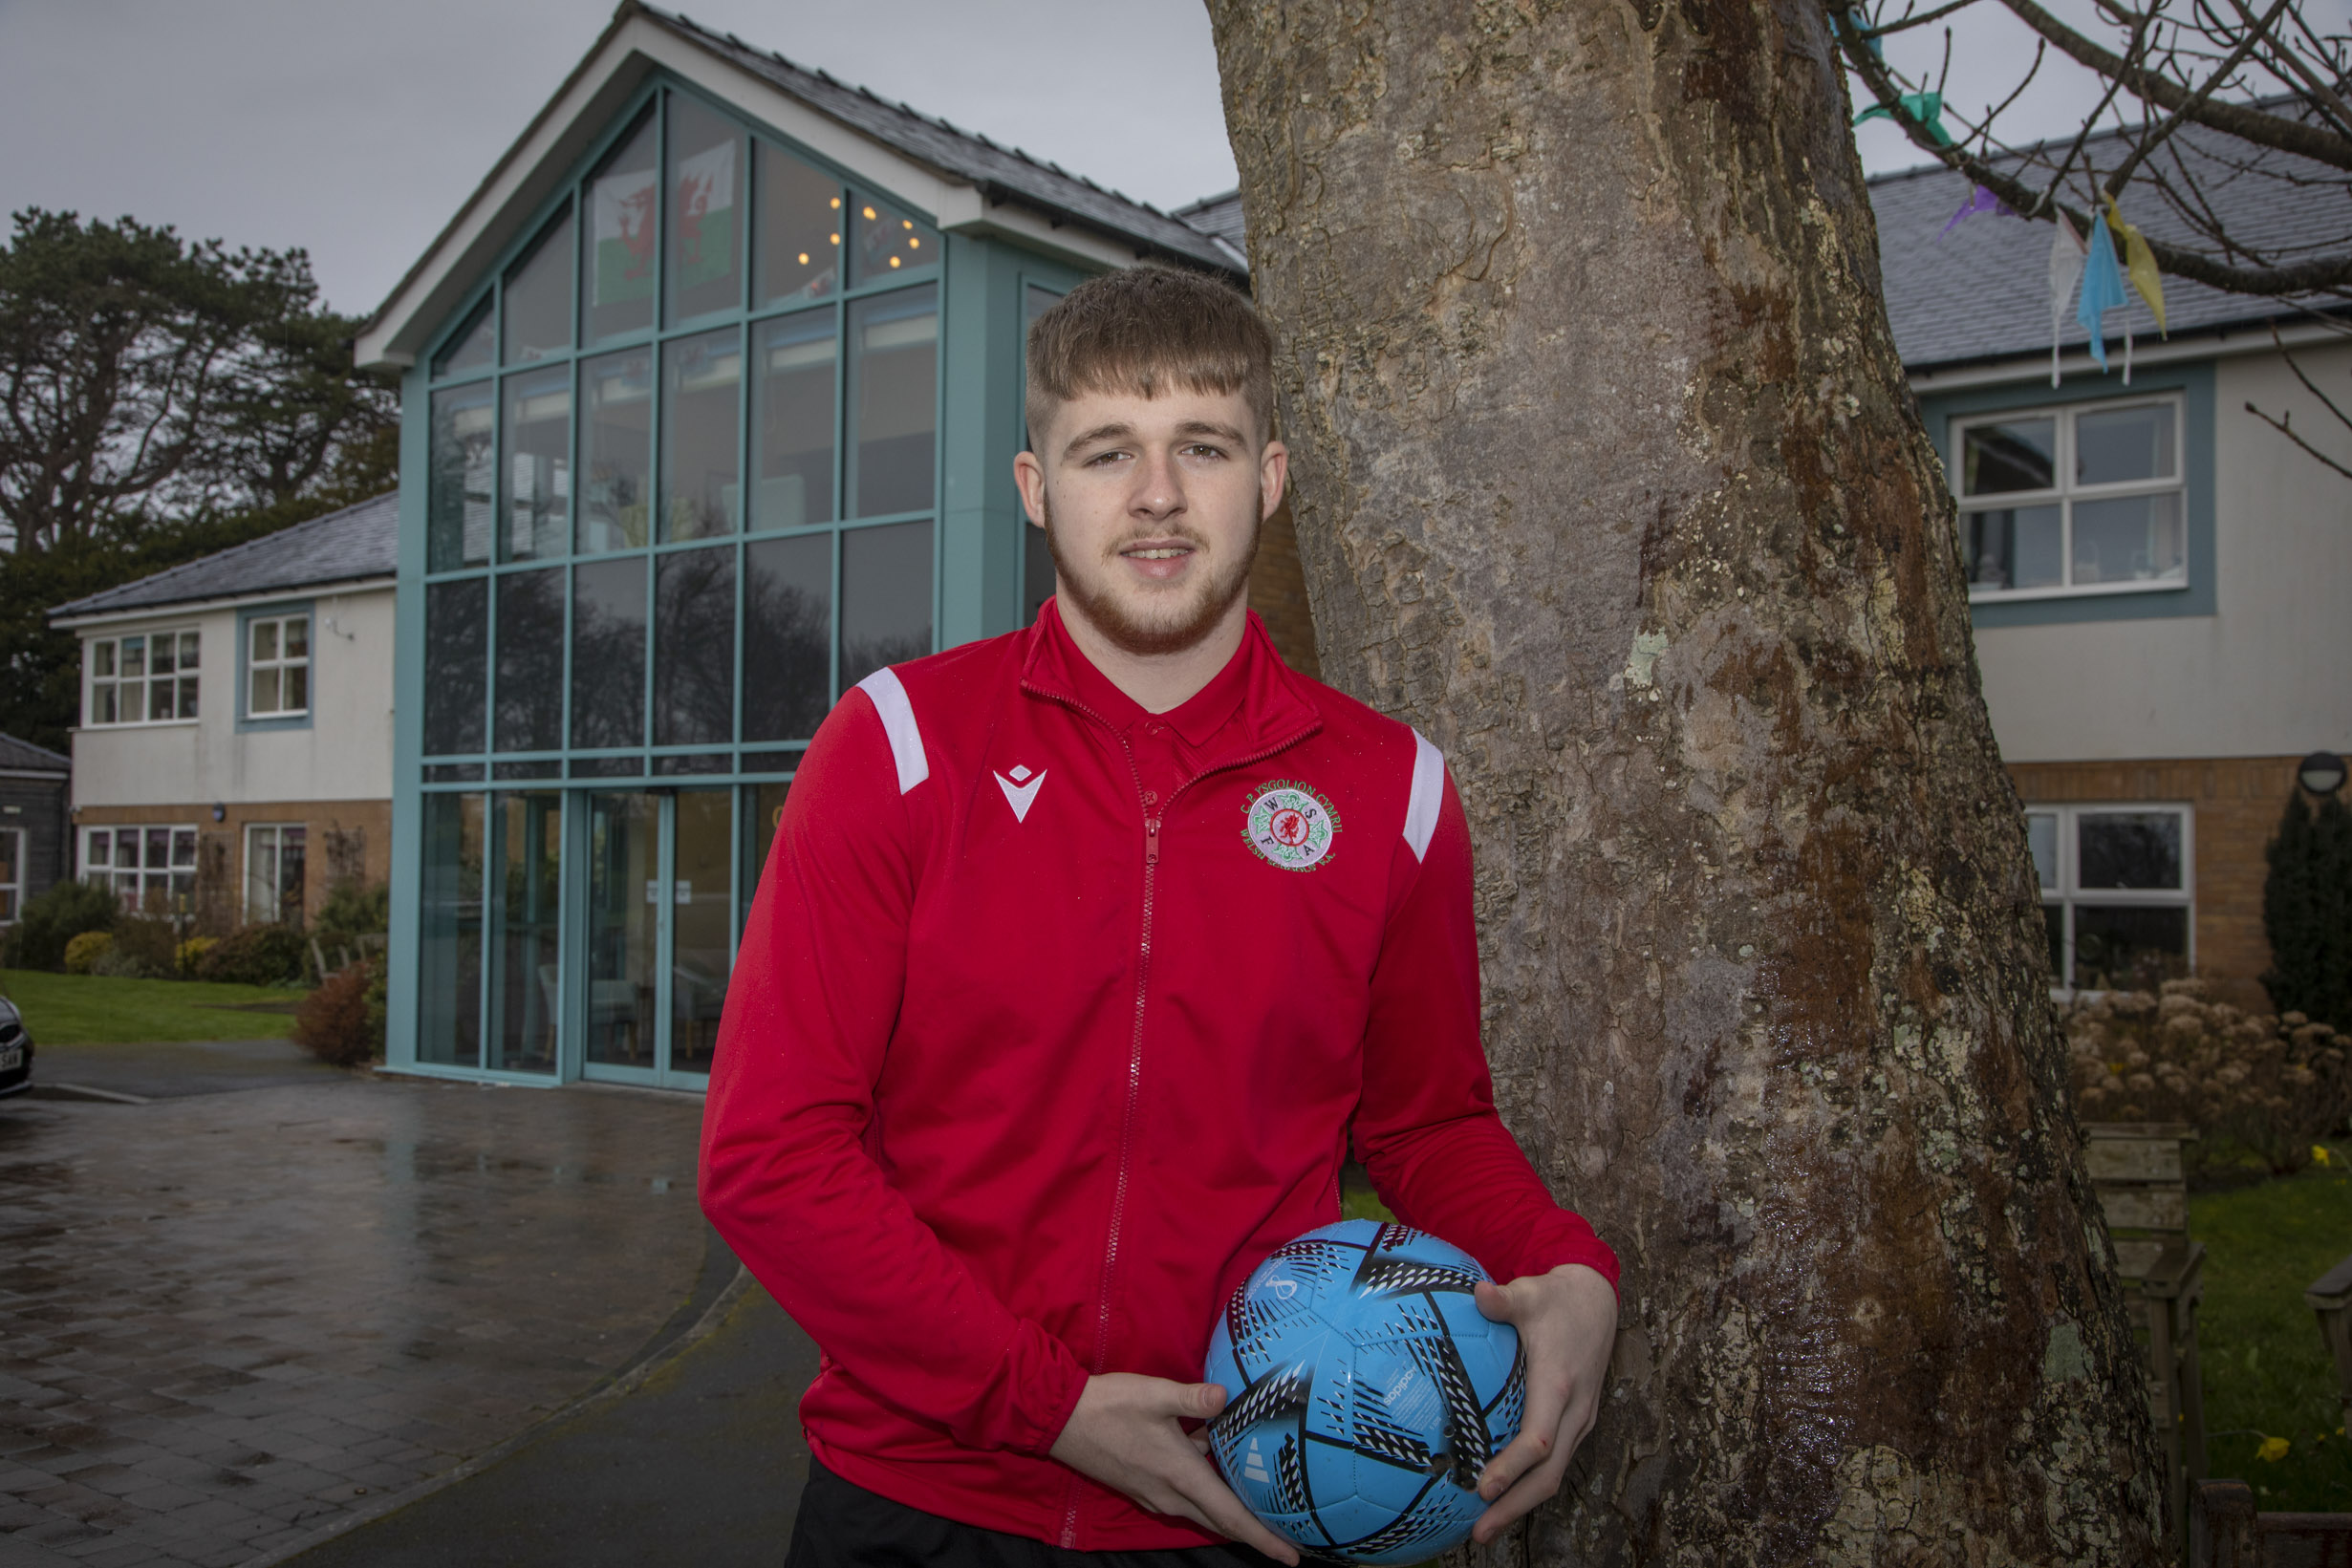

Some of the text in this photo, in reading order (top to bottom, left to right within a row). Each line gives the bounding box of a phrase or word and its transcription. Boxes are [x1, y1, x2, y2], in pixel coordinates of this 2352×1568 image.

[1255, 779, 1316, 796] YSGOLION
[1316, 794, 1343, 833] CYMRU
[1241, 828, 1265, 860] WELSH
[1383, 1369, 1414, 1407] adidas
